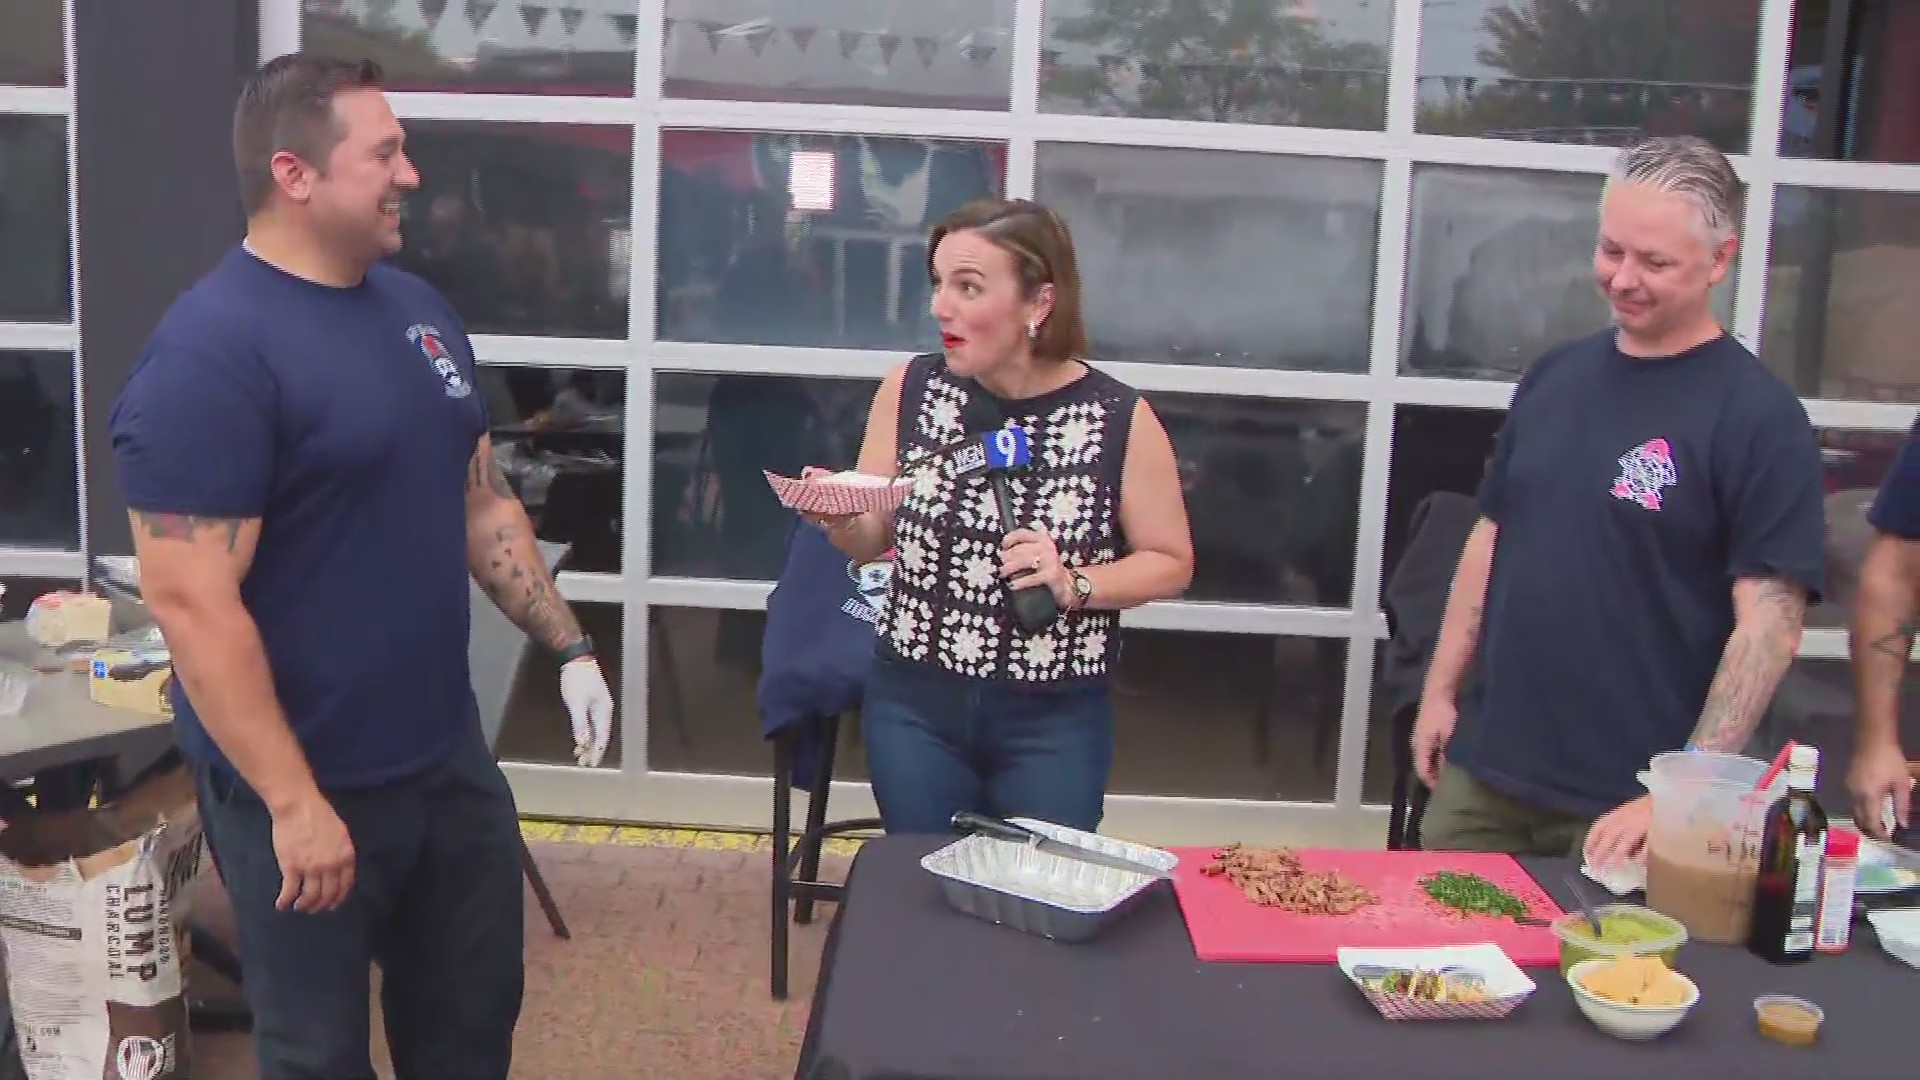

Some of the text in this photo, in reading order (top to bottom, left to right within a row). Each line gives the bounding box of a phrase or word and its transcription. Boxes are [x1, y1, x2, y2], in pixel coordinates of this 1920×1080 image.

[952, 442, 985, 468] WGN
[995, 429, 1016, 468] 9
[105, 884, 124, 980] CHARCOAL
[124, 882, 157, 982] LUMP
